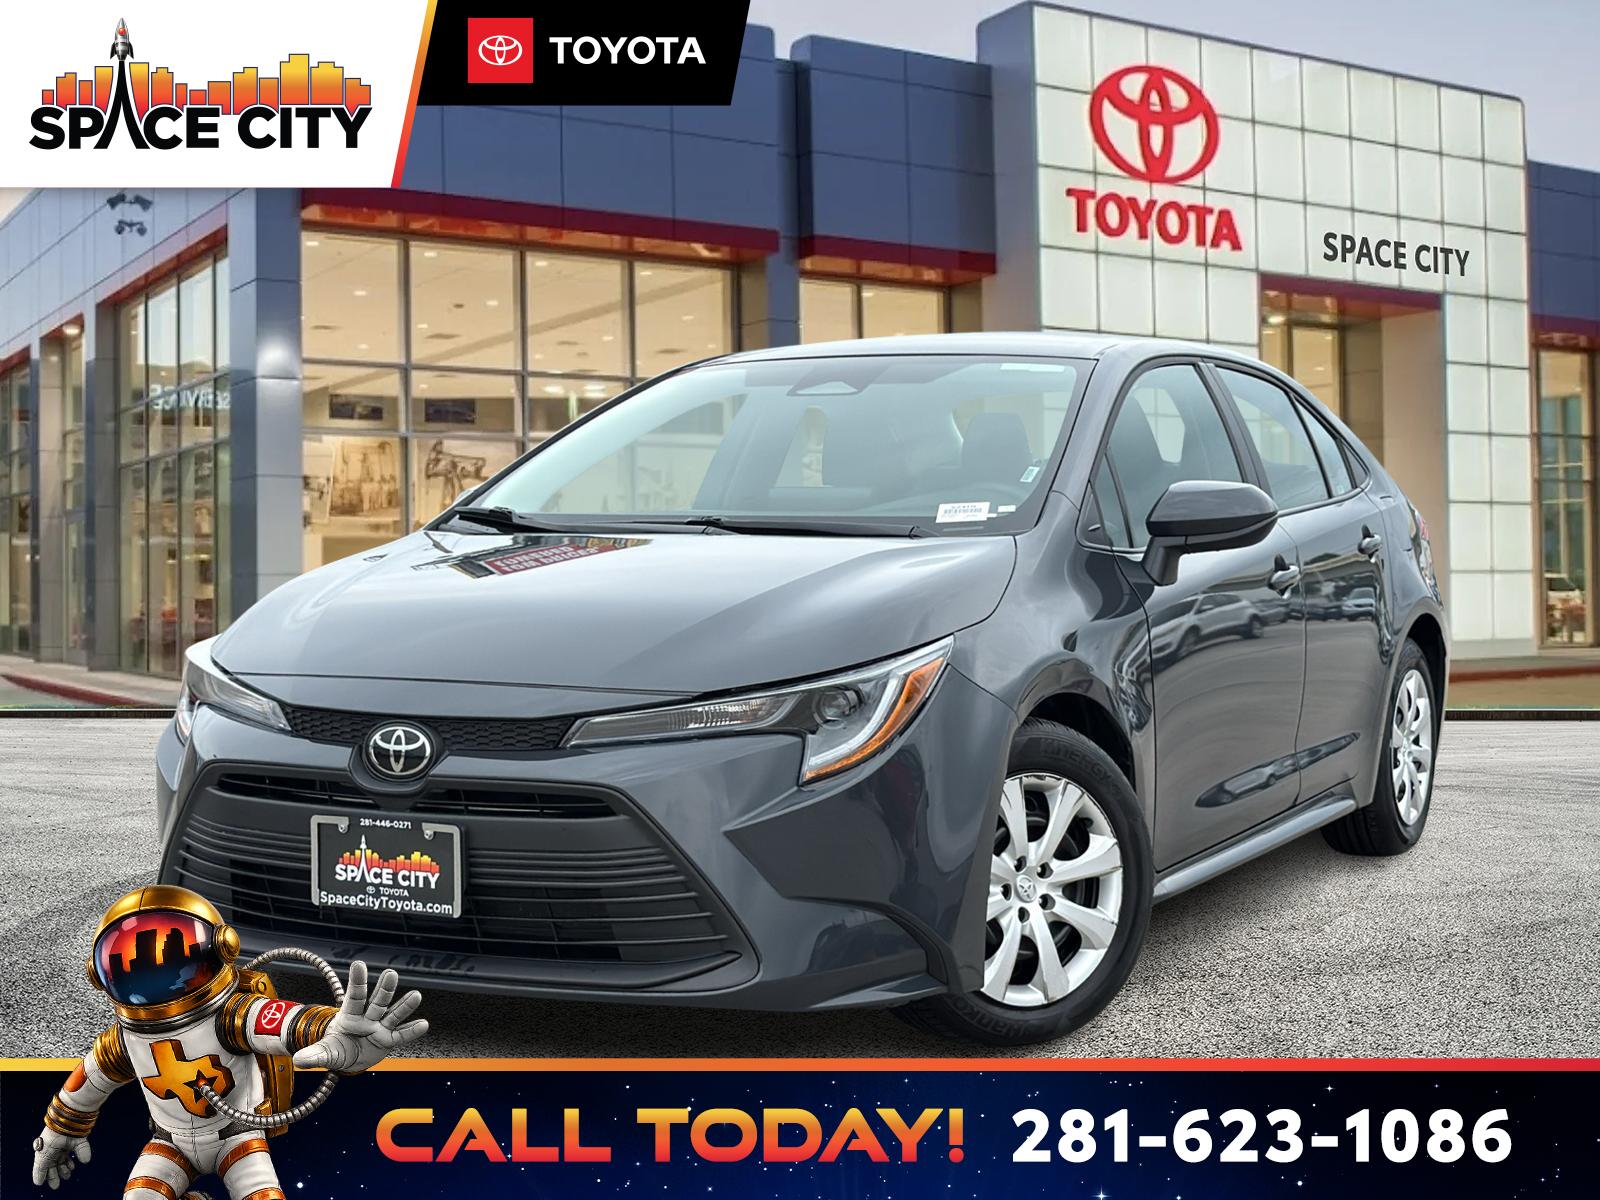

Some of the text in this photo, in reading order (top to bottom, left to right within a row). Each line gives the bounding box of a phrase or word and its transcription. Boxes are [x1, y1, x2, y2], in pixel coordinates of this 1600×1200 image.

[1066, 187, 1243, 253] TOYOTA
[1322, 231, 1470, 277] SPACE CITY
[359, 817, 412, 830] 281-446-0271
[335, 863, 440, 889] SPACE CITY
[320, 890, 453, 915] SpaceCityToyota.com
[379, 886, 410, 897] TOYOTA
